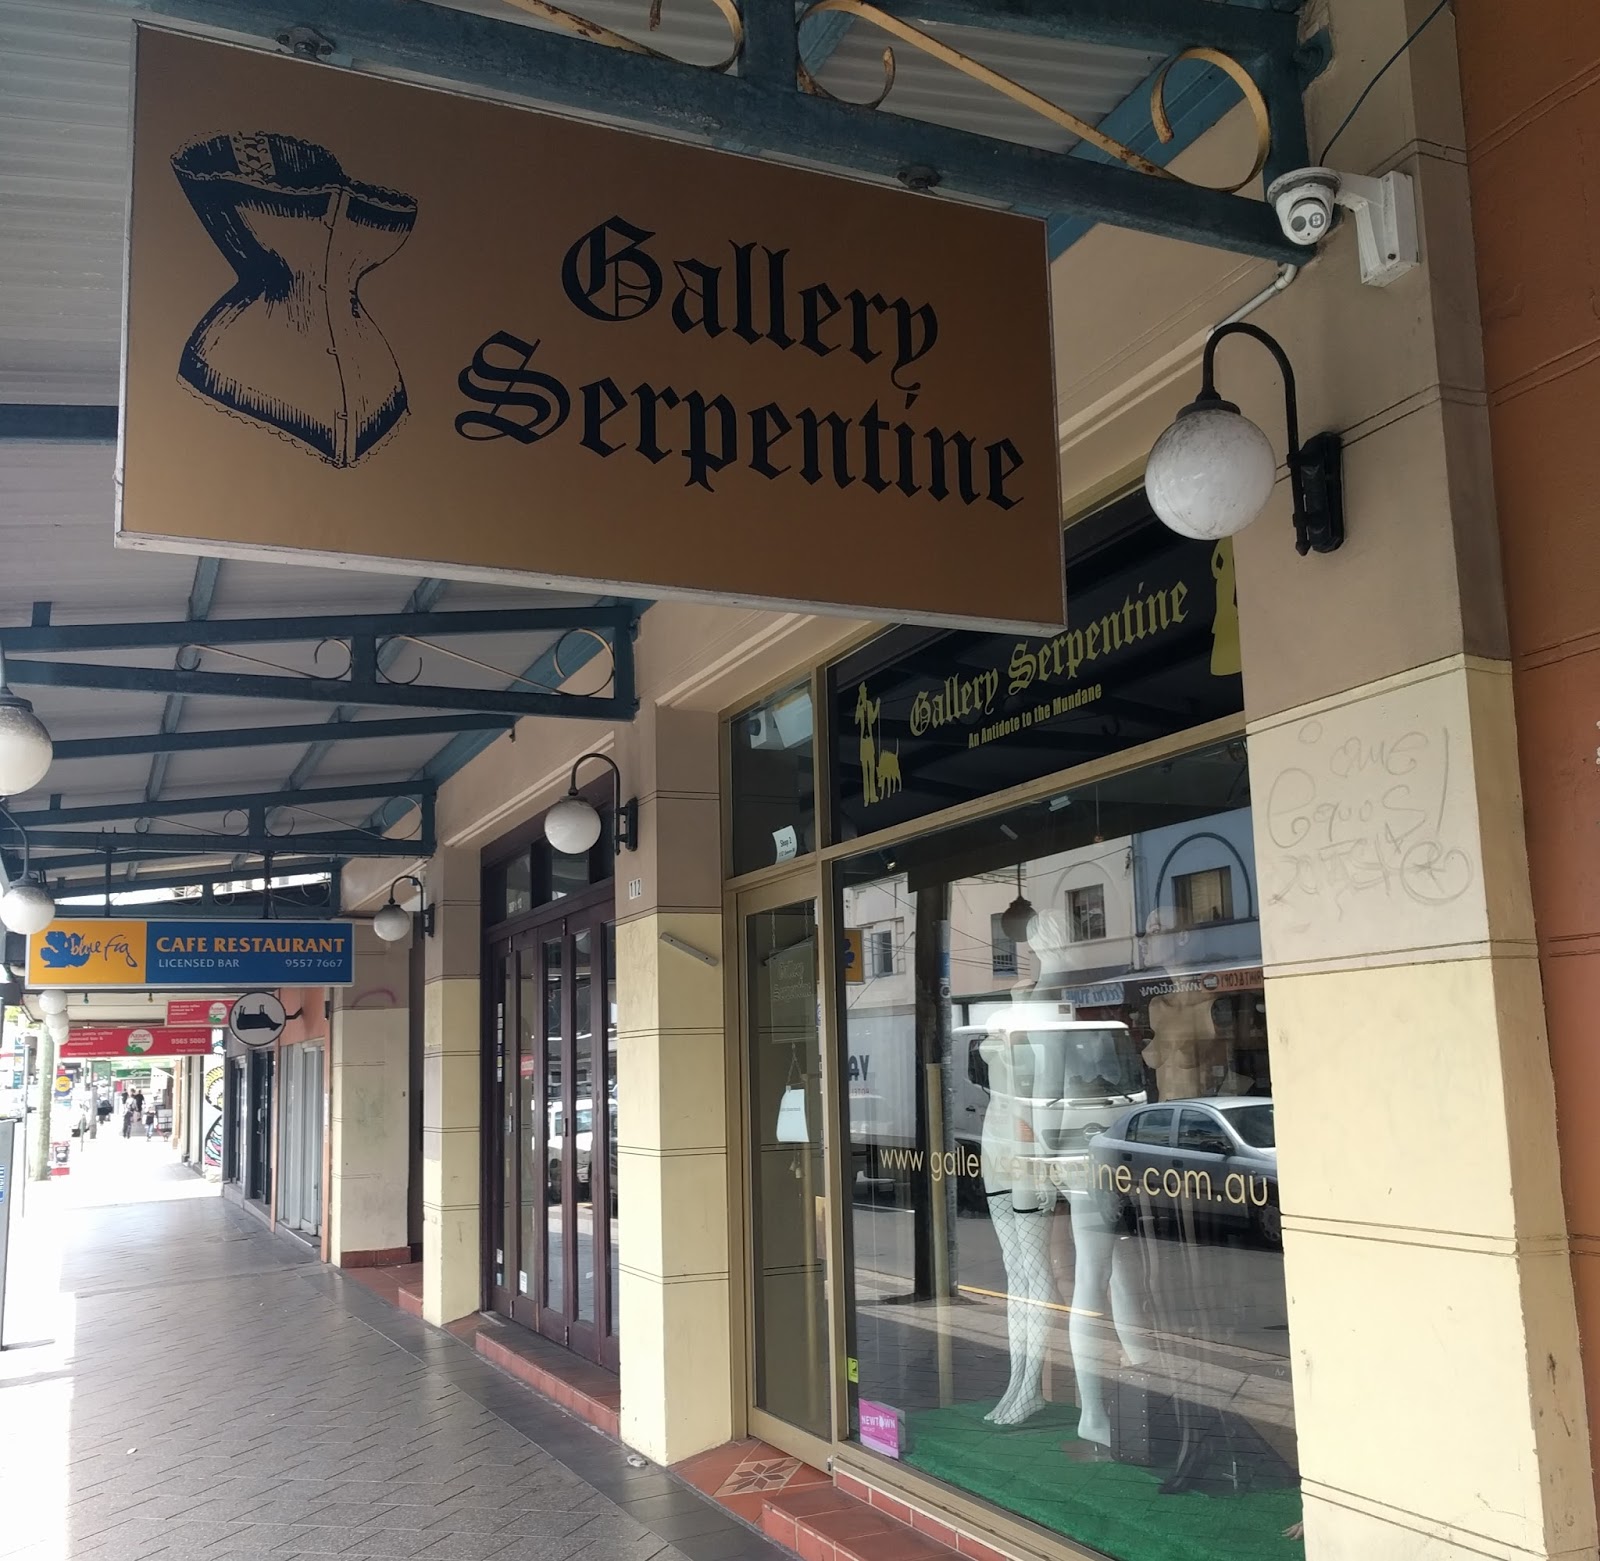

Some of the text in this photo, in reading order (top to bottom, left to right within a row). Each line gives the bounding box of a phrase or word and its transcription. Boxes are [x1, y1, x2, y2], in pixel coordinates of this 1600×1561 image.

[561, 214, 938, 391] Gallery
[454, 329, 1025, 512] Serpentine
[909, 581, 1190, 737] Gallery Serpentine
[968, 682, 1102, 749] An Antidote to the Mundane
[629, 880, 642, 897] 112
[156, 936, 345, 953] CAFE RESTAURANT
[158, 958, 240, 968] LICENSED BAR
[285, 958, 343, 968] 9557 7667
